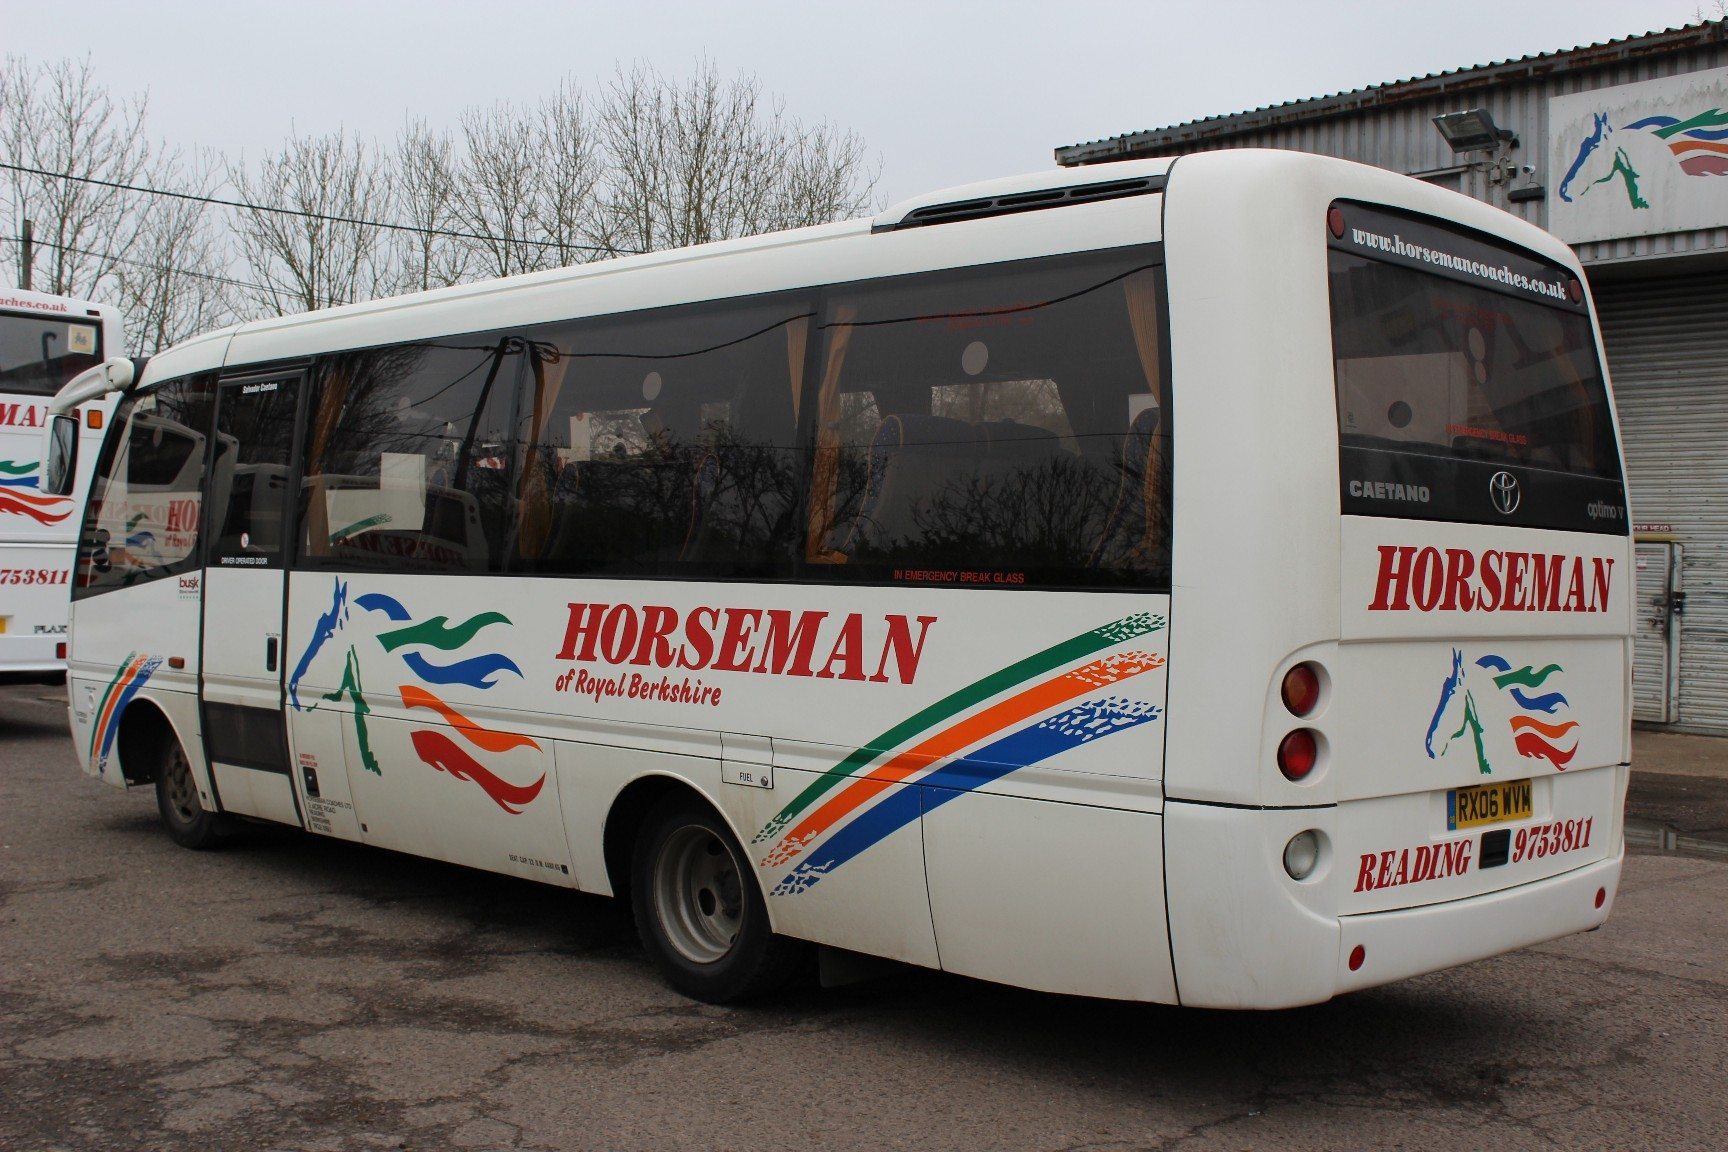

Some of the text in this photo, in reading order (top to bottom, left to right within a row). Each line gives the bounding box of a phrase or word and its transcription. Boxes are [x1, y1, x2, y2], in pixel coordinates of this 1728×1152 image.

[1351, 227, 1567, 301] www.horsemancoaches.co.uk
[1349, 480, 1430, 503] CAETANO
[894, 570, 1025, 584] IN EMERGENCY BREAK GLASS
[1368, 545, 1615, 613] HORSEMAN
[33, 624, 67, 634] PLAX
[555, 602, 938, 685] HORSEMAN
[555, 668, 722, 707] of Royal Berkshire
[739, 771, 754, 783] FUEL
[1458, 784, 1531, 822] RX06 WVM
[1353, 816, 1594, 893] READING 9753811
